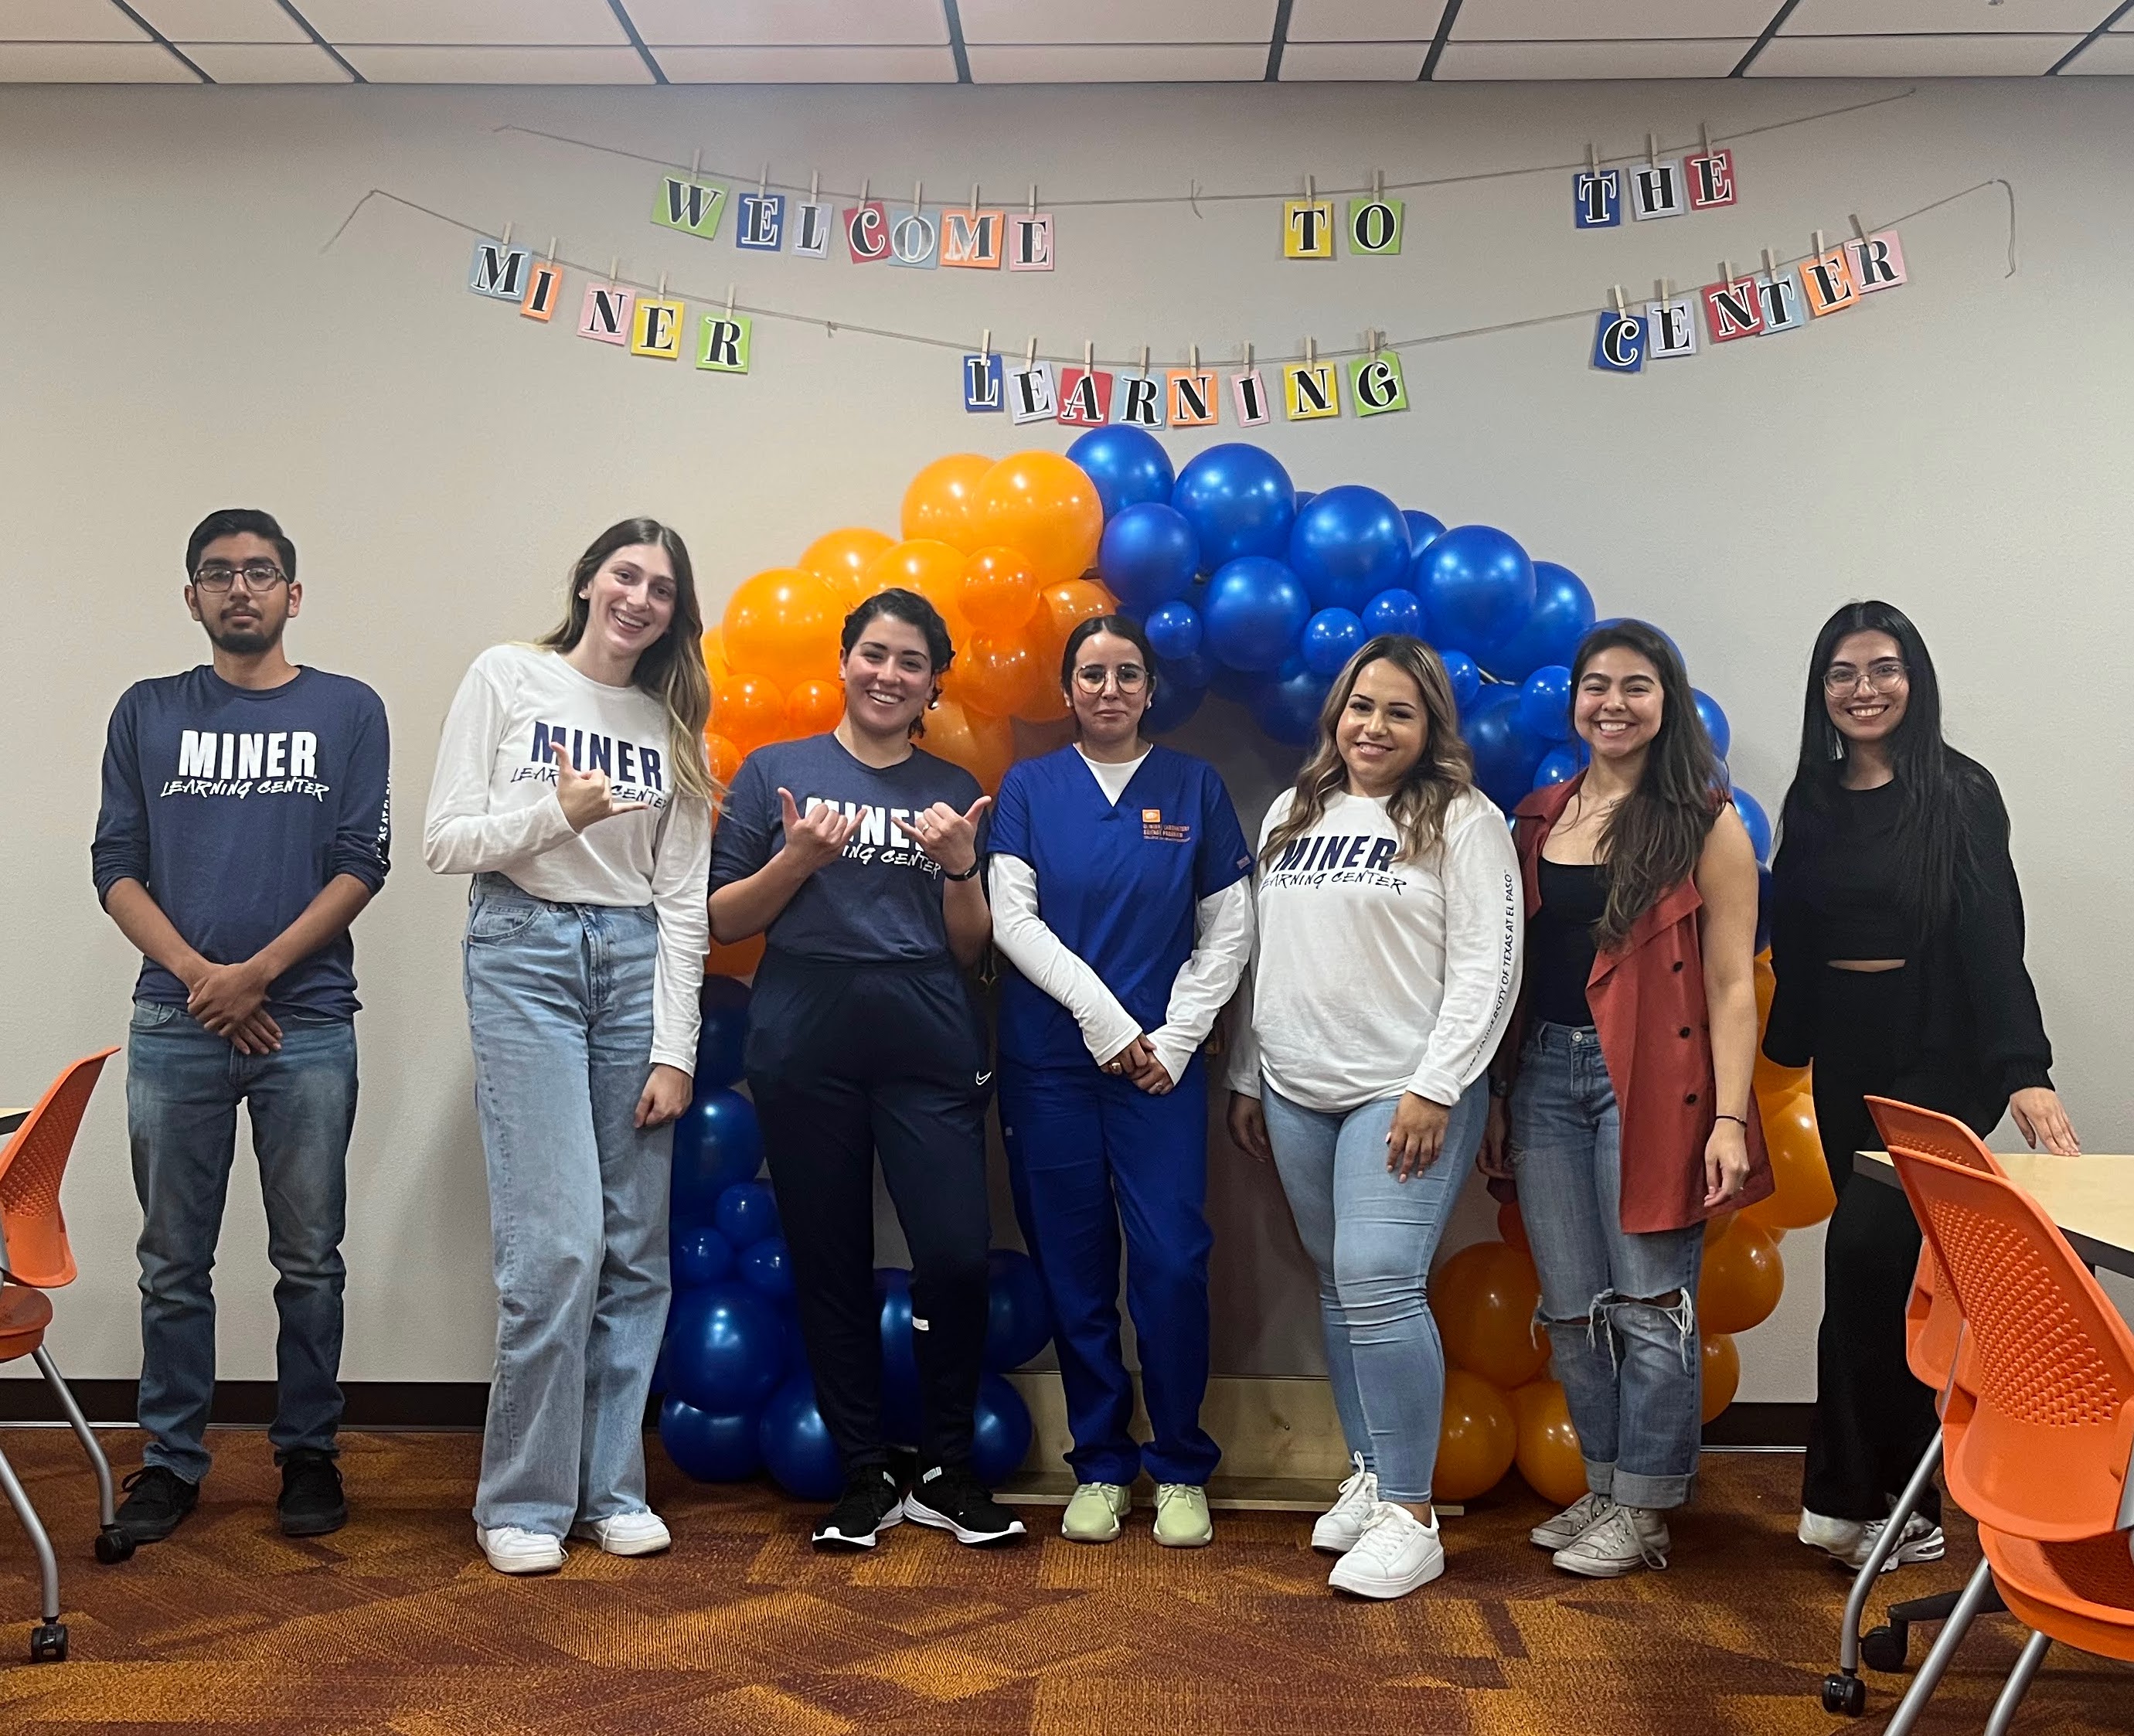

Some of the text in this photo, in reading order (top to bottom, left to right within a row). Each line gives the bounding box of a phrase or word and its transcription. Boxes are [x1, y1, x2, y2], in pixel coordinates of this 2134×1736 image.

[663, 156, 1734, 267] WELCOME TO THE
[471, 240, 1901, 426] MINER LEARNING CENTER
[179, 730, 317, 780] MINER
[531, 721, 662, 791] MINER
[160, 776, 330, 802] LEARNING CENTER
[510, 766, 560, 788] LEAR
[880, 849, 941, 880] CENTER
[1271, 836, 1397, 873] MINER
[1260, 870, 1407, 896] EARNING CENTER
[1504, 873, 1514, 902] PASO
[1506, 905, 1514, 917] EL
[1506, 919, 1514, 933] AT
[1503, 933, 1514, 968] TEXAS
[1501, 968, 1510, 985] OF
